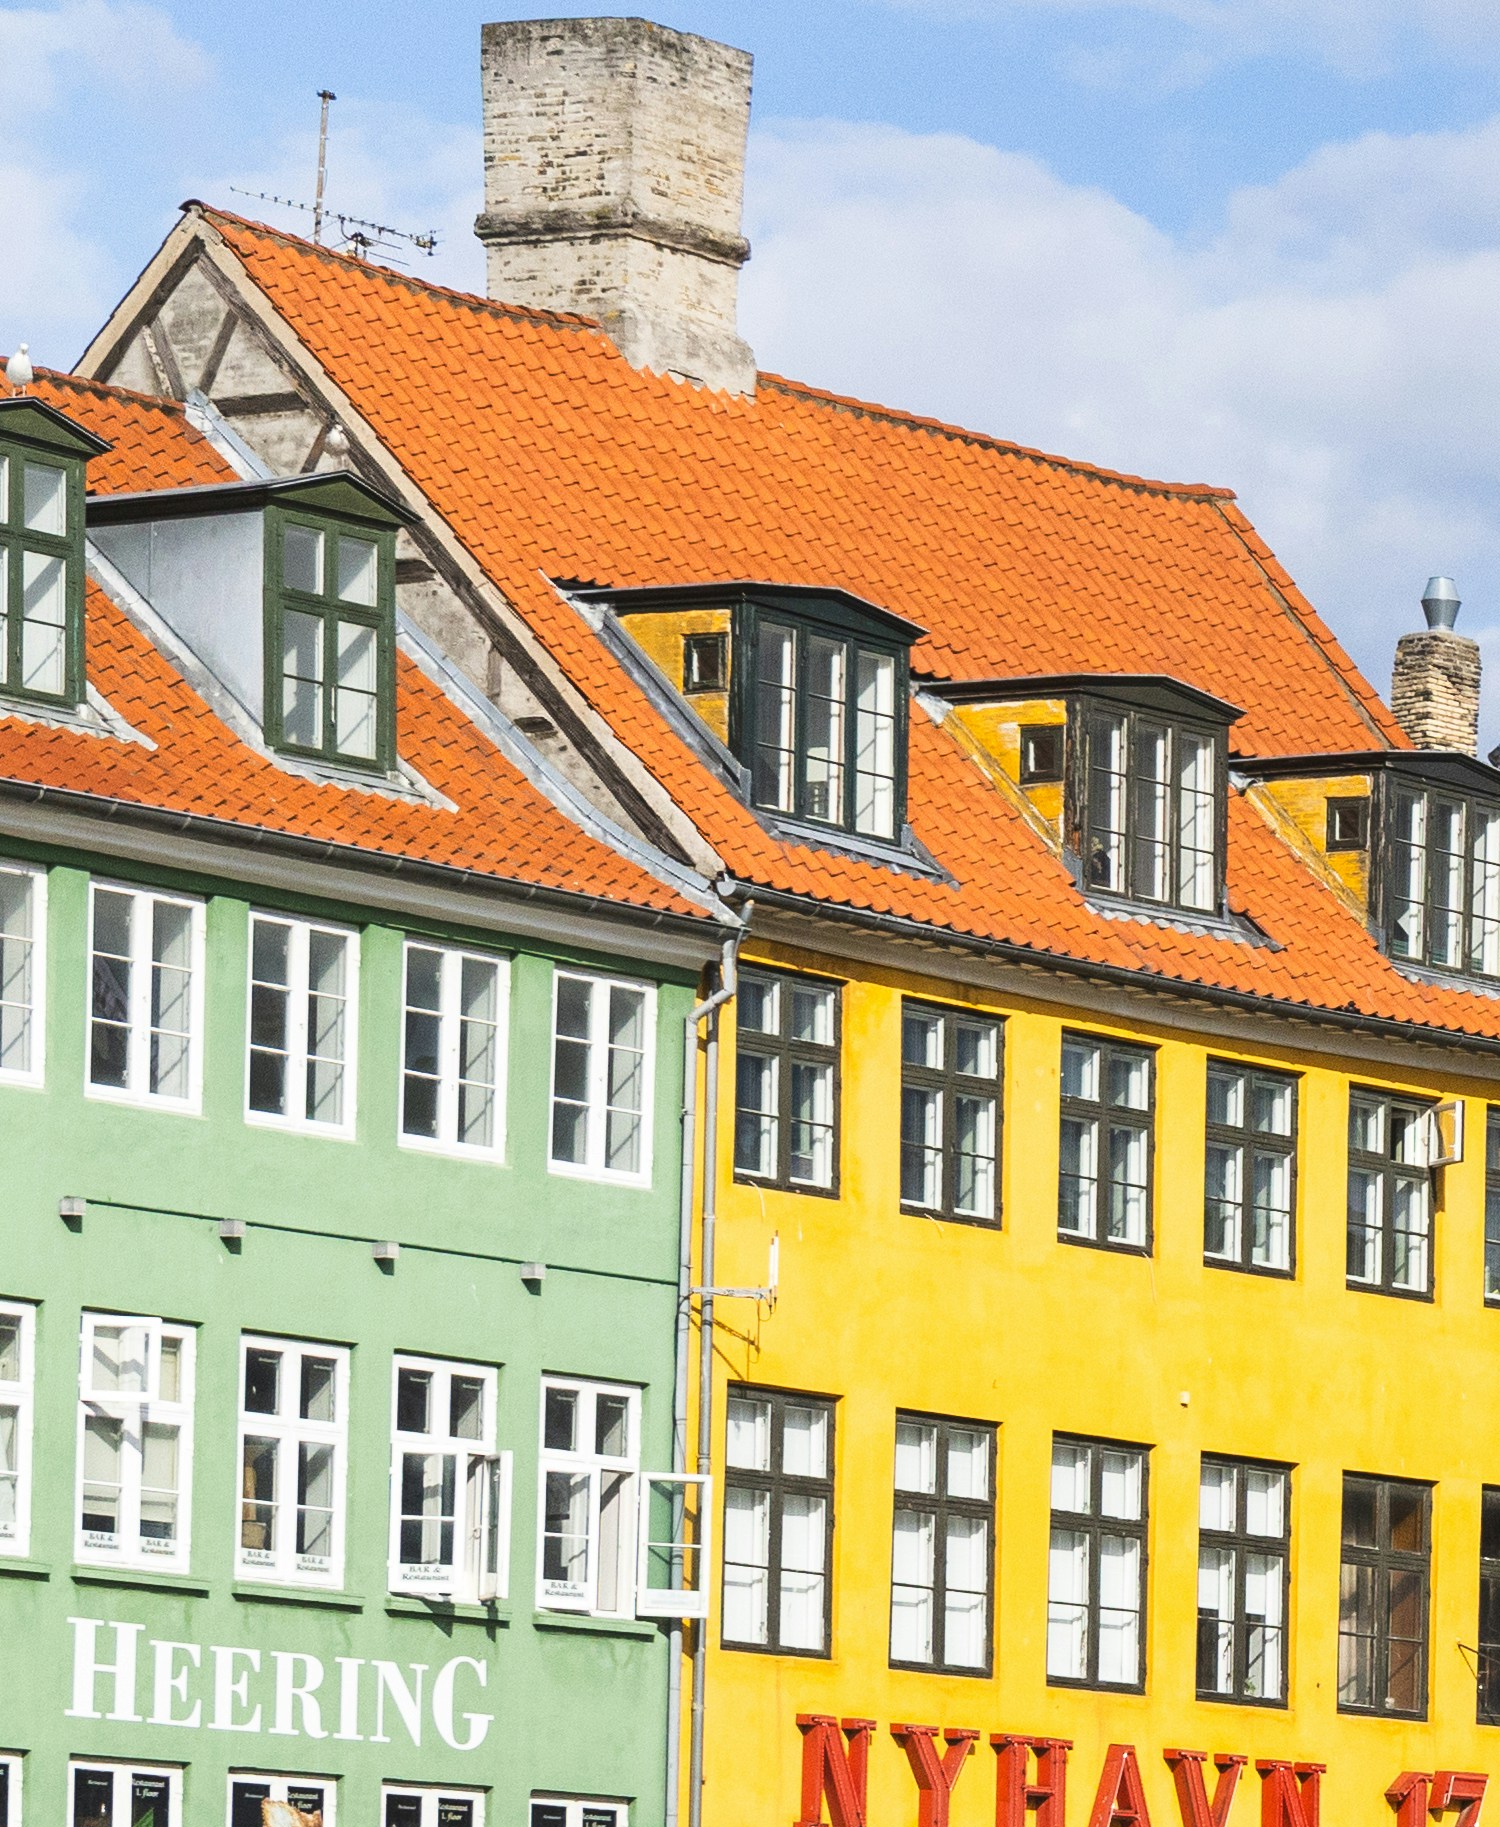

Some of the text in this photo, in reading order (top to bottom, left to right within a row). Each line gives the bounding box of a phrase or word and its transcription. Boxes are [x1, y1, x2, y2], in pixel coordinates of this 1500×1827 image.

[409, 1565, 431, 1575] BAR
[402, 1572, 450, 1584] Restaurant
[550, 1581, 568, 1590] BAR
[64, 1616, 496, 1751] HEERING
